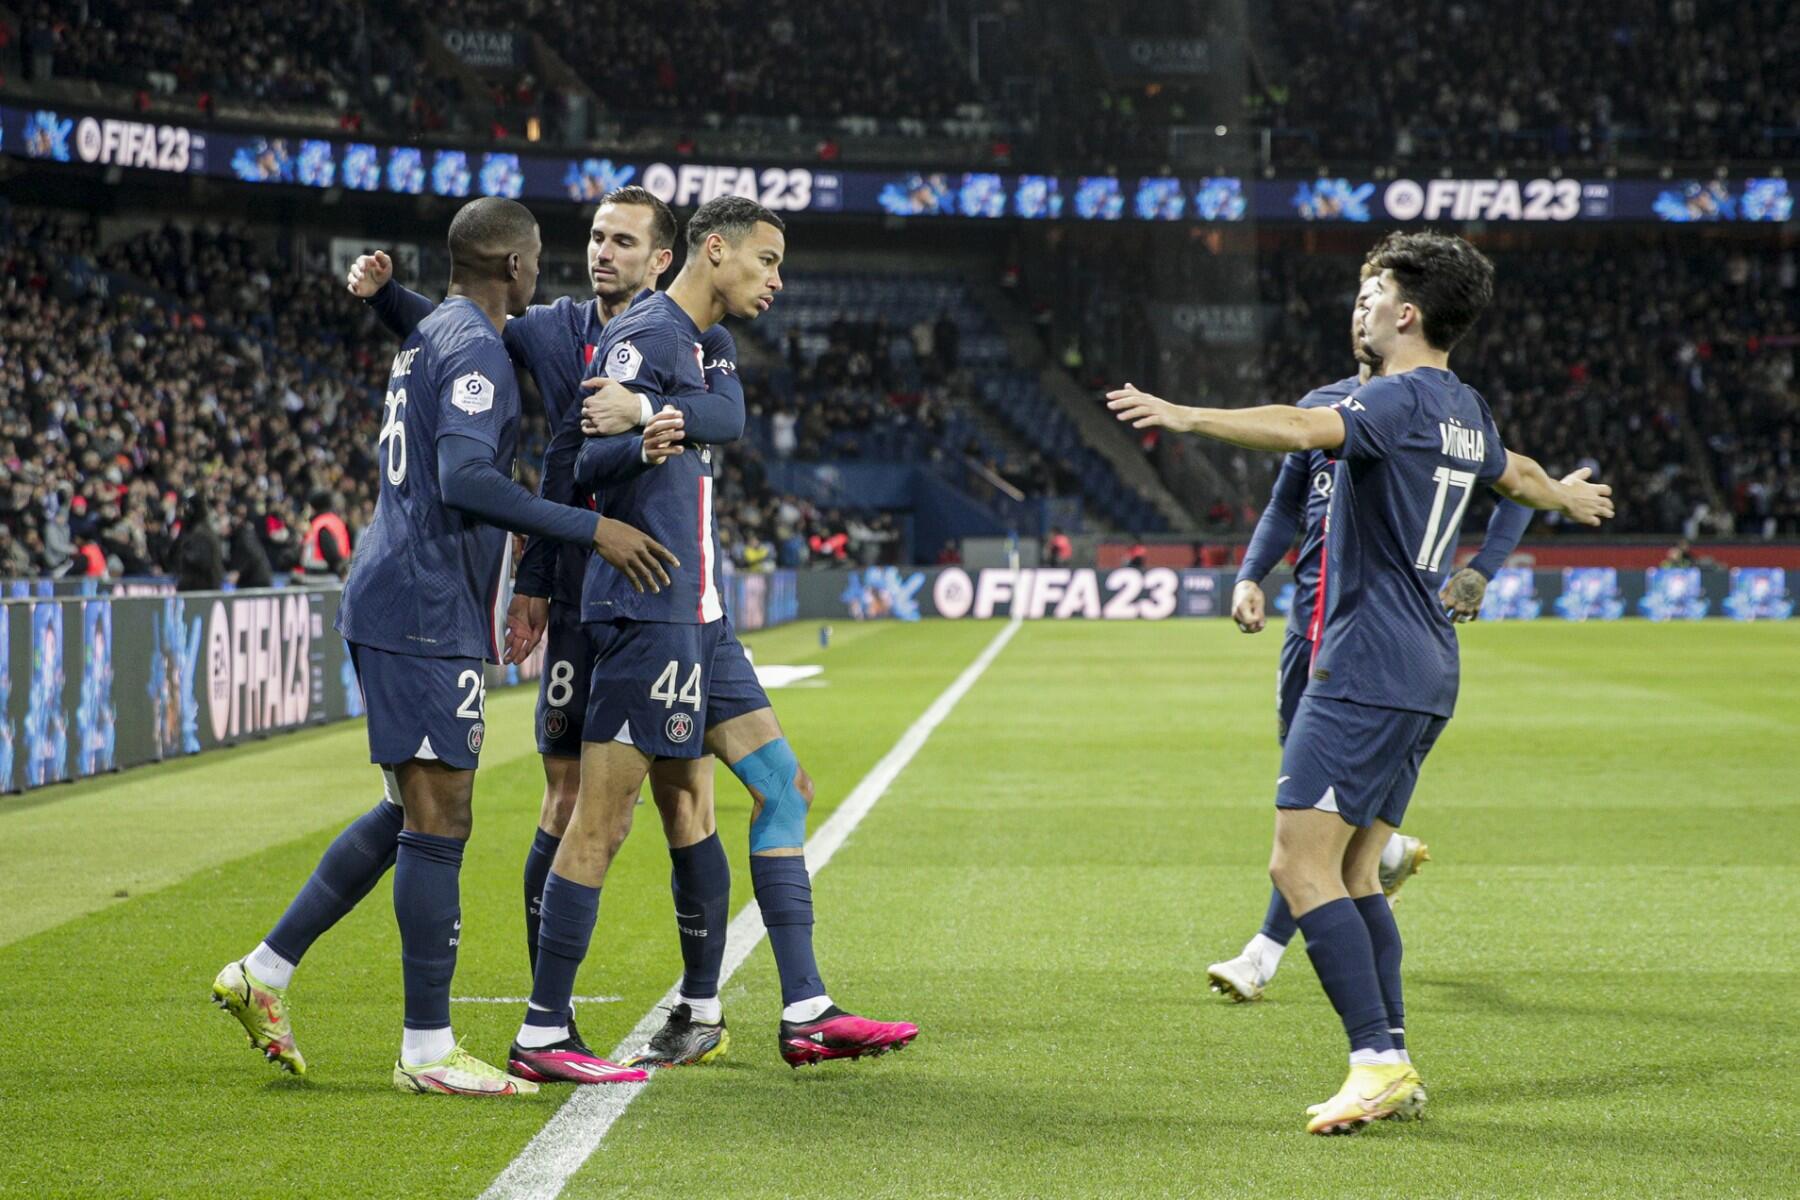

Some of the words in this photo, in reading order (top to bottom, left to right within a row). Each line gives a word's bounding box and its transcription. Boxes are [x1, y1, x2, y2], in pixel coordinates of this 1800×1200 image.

[1415, 466, 1476, 573] 17
[547, 660, 574, 707] 8
[650, 660, 702, 712] 44
